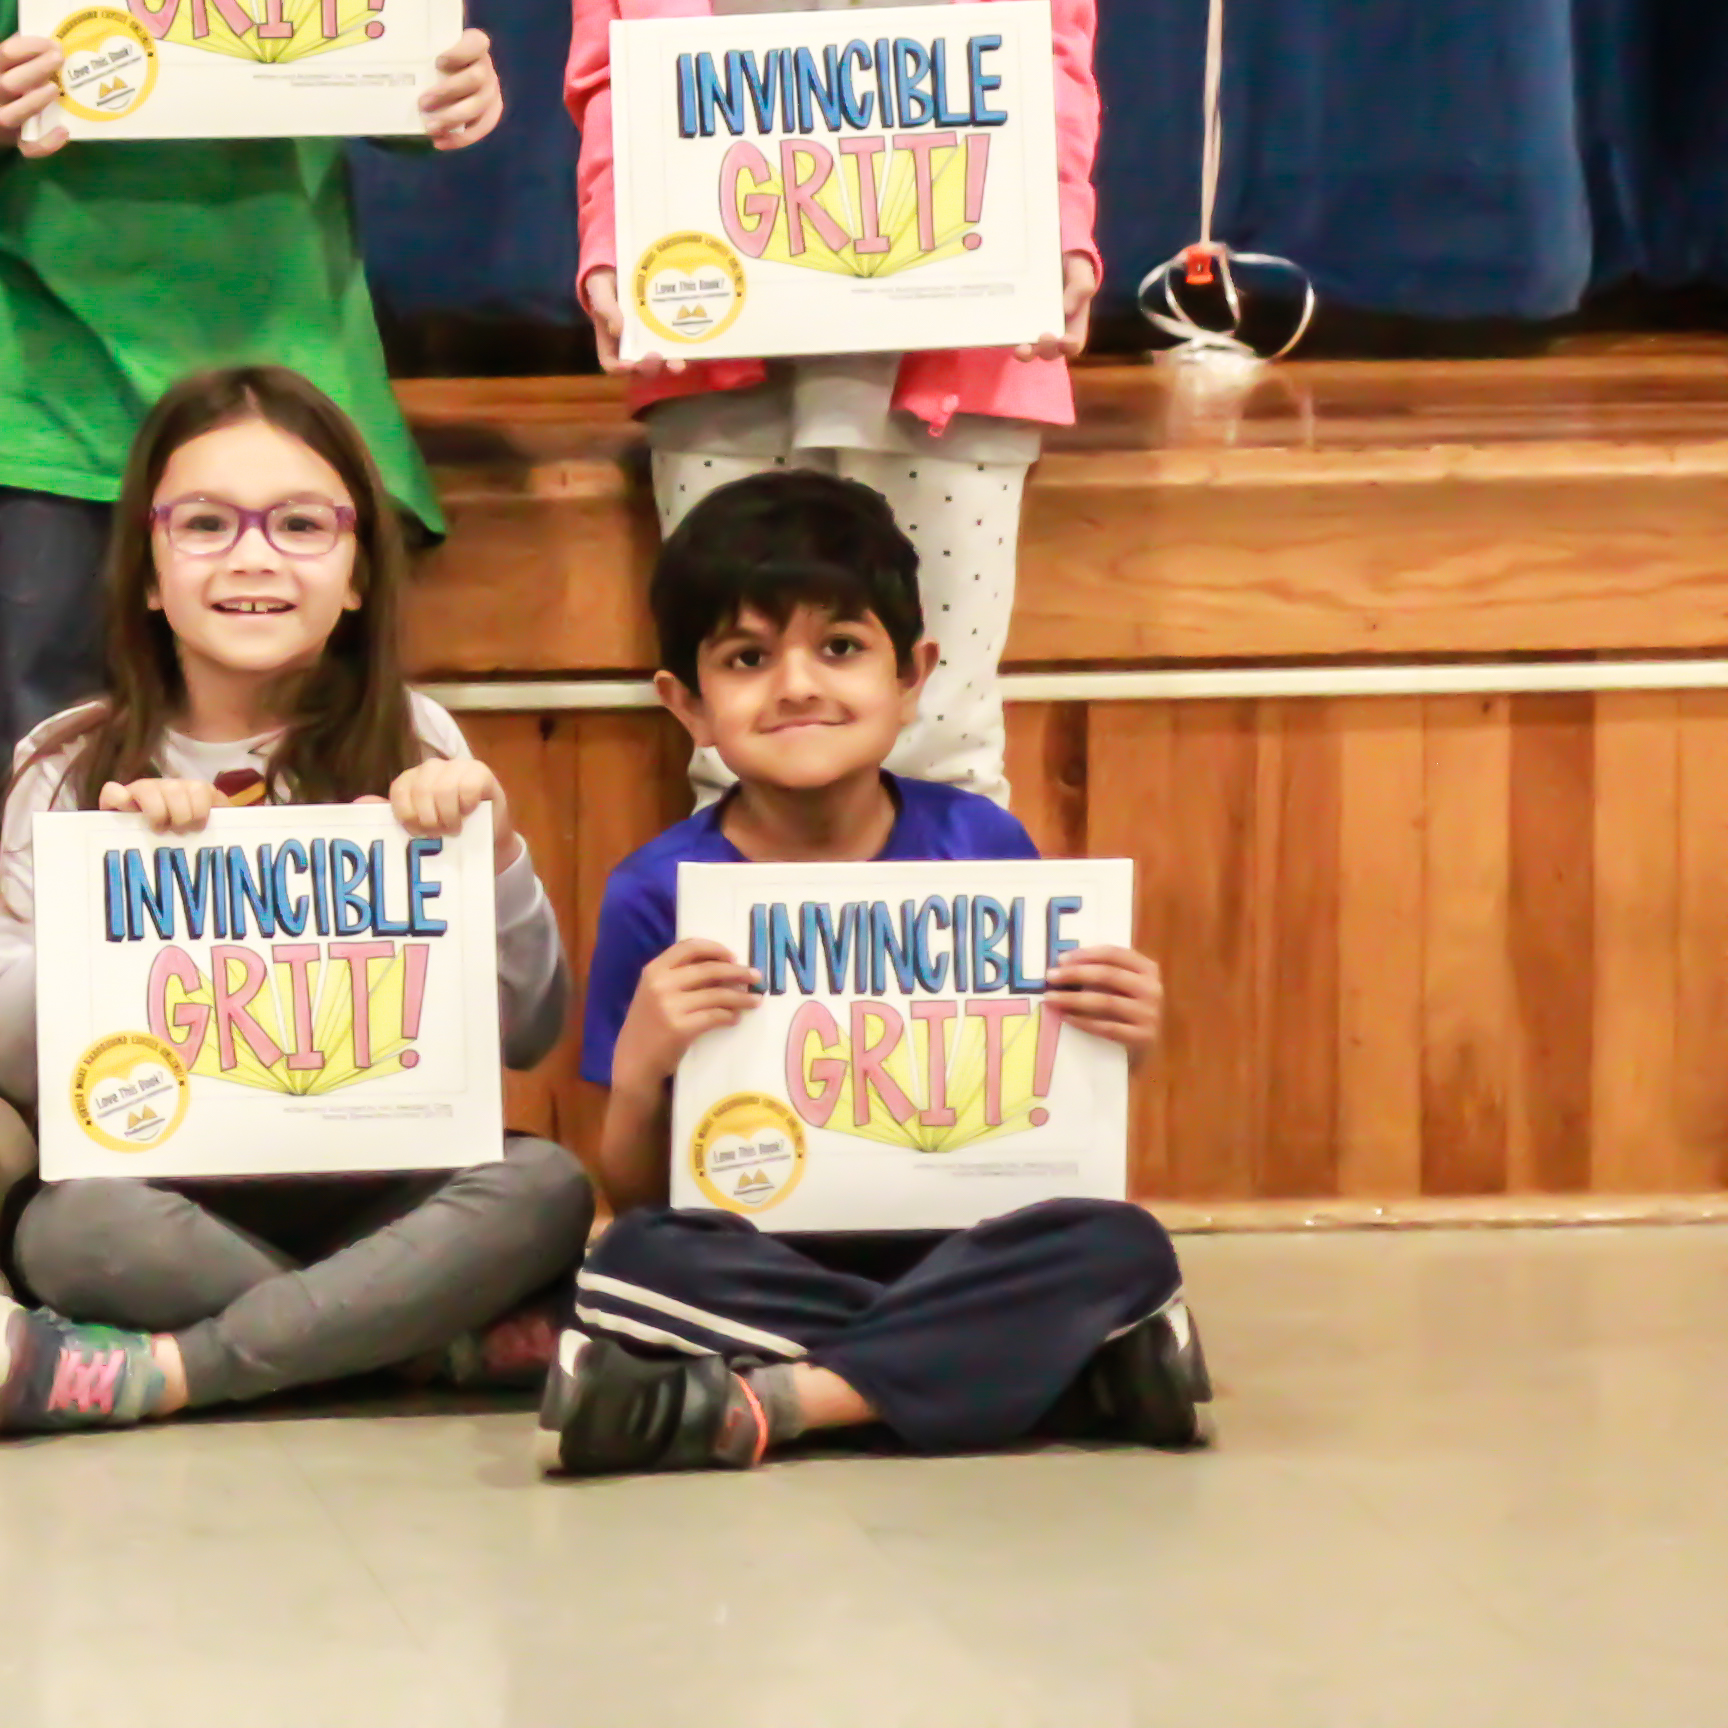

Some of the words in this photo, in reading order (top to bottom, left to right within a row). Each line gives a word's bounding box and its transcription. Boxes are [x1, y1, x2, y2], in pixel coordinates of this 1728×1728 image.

[678, 37, 1006, 138] INVINCIBLE
[720, 133, 990, 257] GRIT!
[105, 839, 444, 942] INVINCIBLE
[749, 895, 1084, 996] INVINCIBLE
[148, 941, 429, 1069] GRIT!
[786, 999, 1074, 1126] GRIT!
